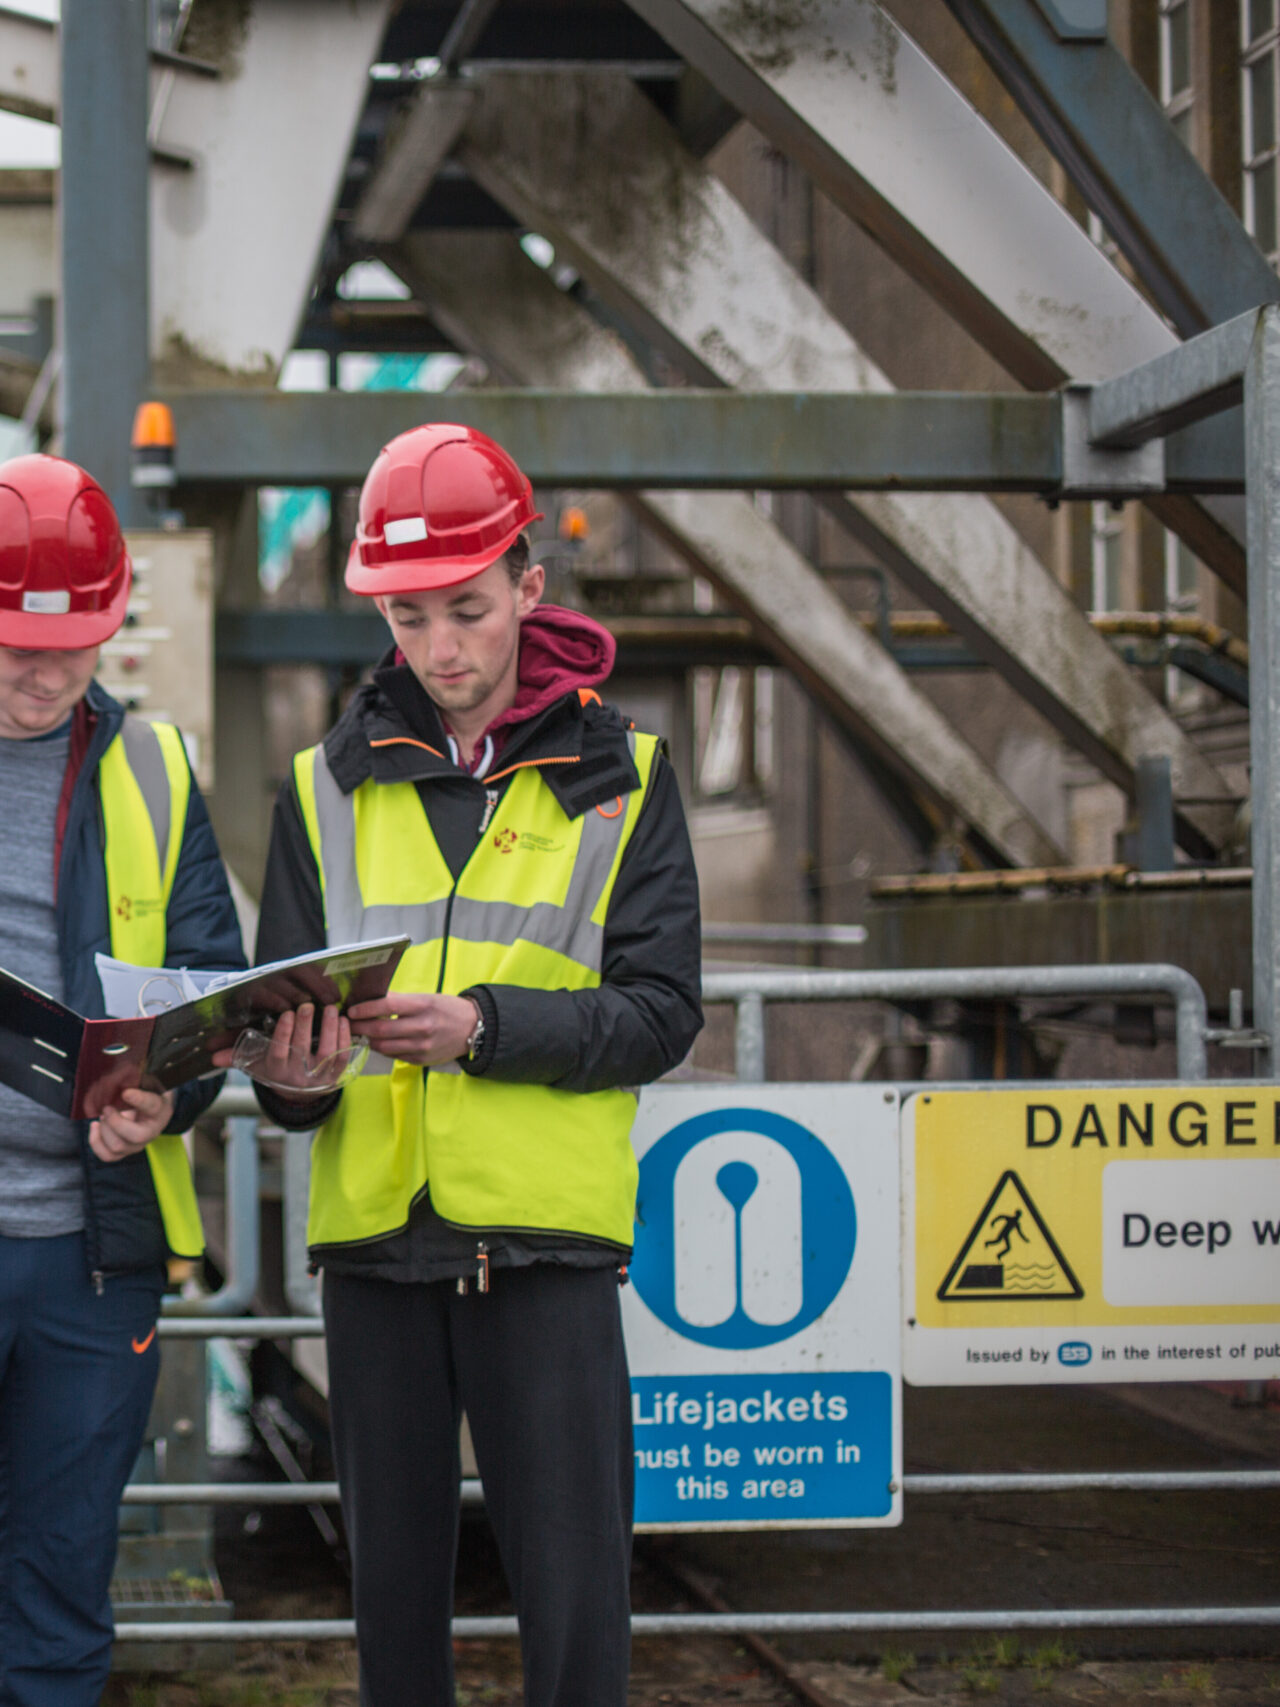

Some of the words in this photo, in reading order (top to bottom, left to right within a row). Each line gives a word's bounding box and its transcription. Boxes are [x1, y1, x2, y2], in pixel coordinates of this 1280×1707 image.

[1026, 1100, 1280, 1148] DANGE
[1122, 1212, 1232, 1254] Deep
[966, 1347, 1023, 1363] Issued
[1030, 1347, 1050, 1364] by
[1101, 1345, 1116, 1361] in
[1124, 1345, 1150, 1360] the
[1158, 1344, 1222, 1360] interest
[1229, 1343, 1246, 1358] of
[631, 1390, 849, 1431] Lifejackets
[704, 1443, 741, 1467] be
[753, 1445, 824, 1466] worn
[836, 1438, 861, 1464] in
[676, 1475, 729, 1500] this
[741, 1478, 806, 1499] area
